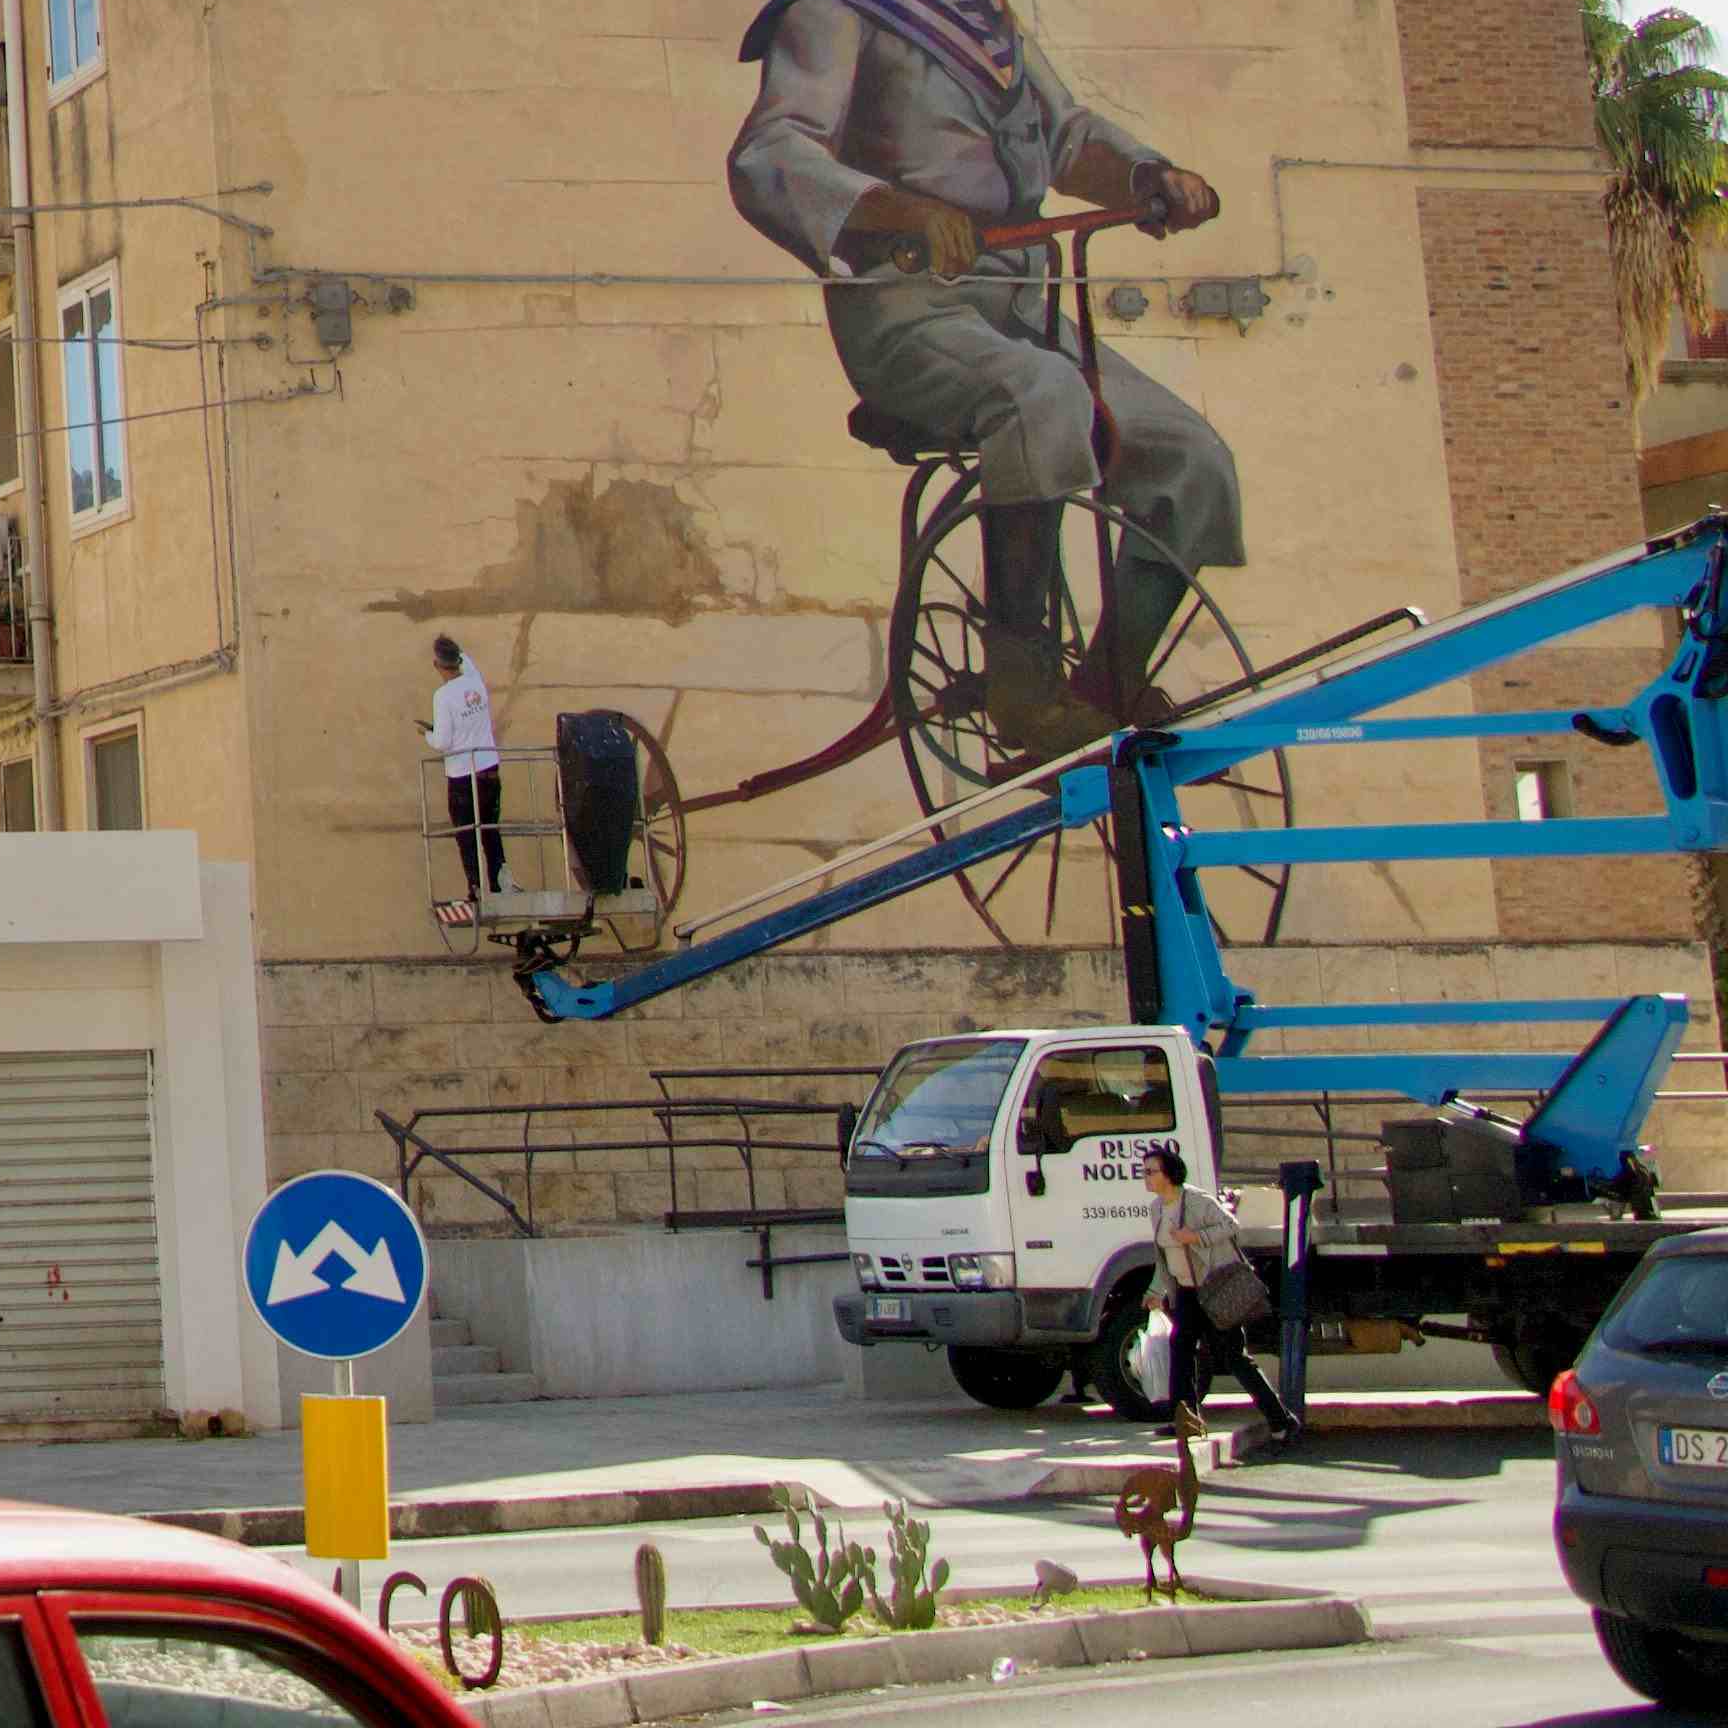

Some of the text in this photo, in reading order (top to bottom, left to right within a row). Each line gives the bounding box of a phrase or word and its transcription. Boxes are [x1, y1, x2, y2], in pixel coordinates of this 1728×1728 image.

[1100, 1138, 1181, 1160] RUSSO
[1082, 1163, 1145, 1181] NOLE
[1675, 1433, 1704, 1461] DS
